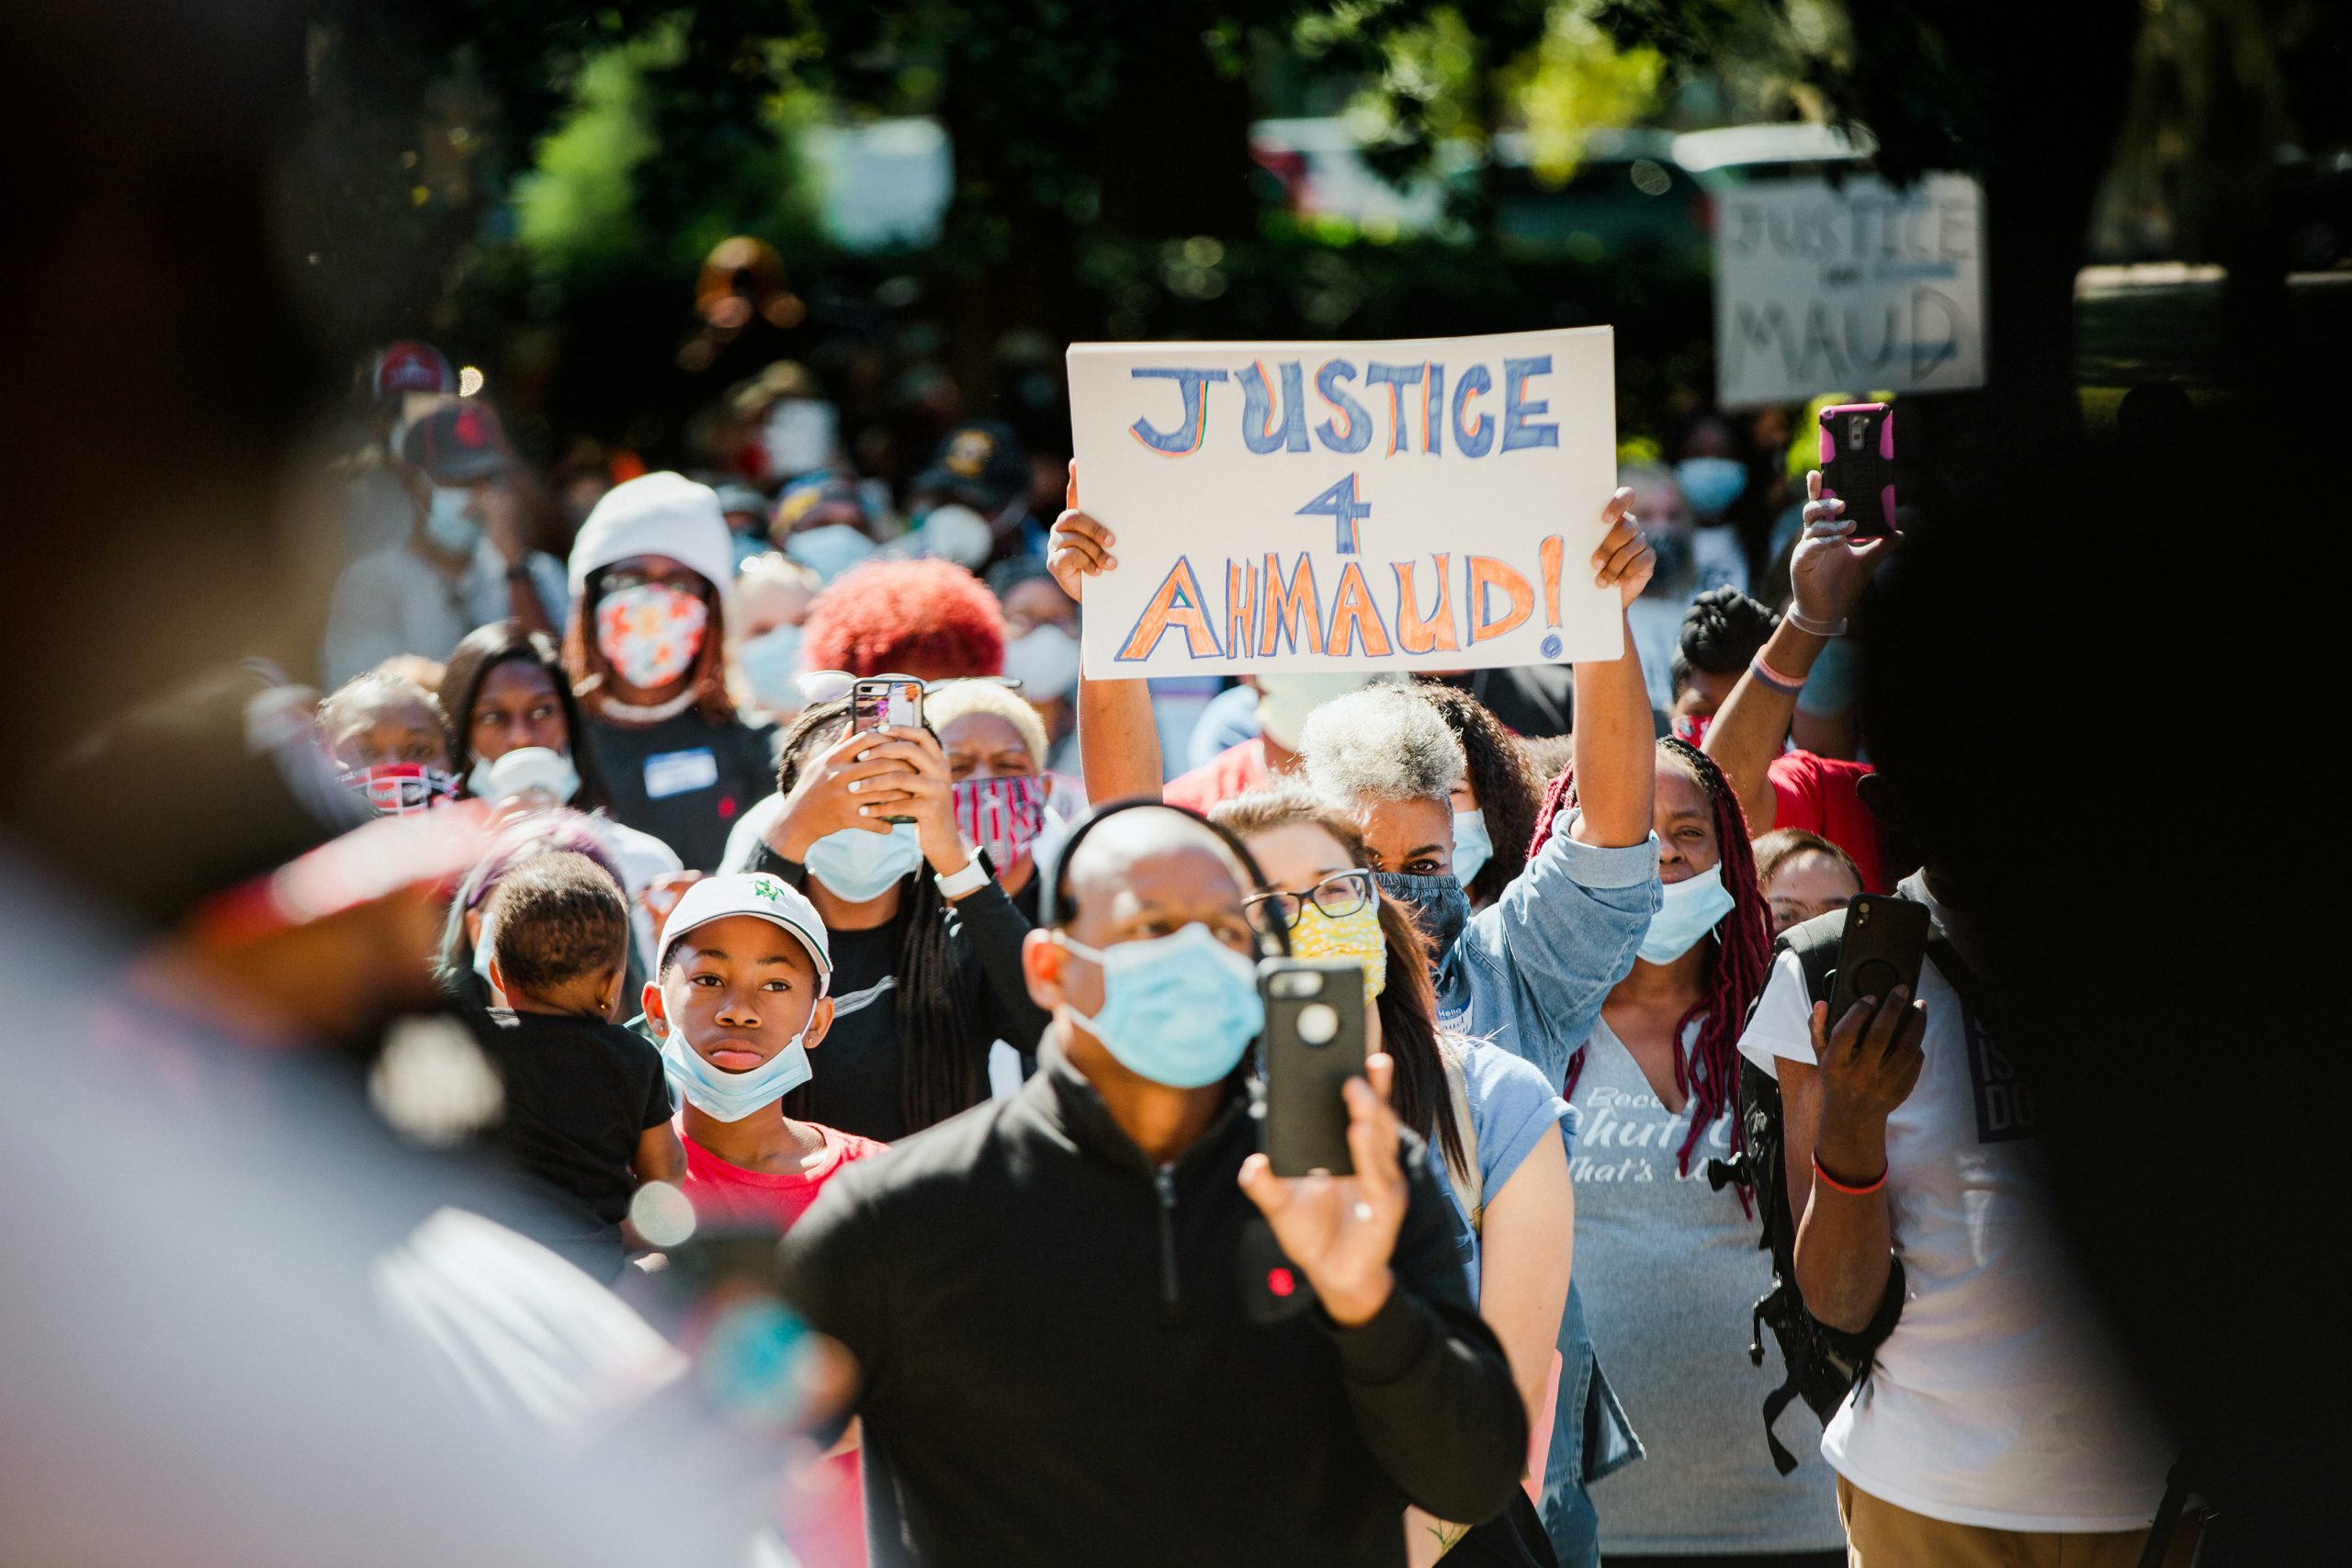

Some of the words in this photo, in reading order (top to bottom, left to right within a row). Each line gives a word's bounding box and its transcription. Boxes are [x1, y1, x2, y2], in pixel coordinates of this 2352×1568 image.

[1727, 192, 1975, 261] JUSTICE
[1727, 284, 1962, 385] MAUD
[1129, 355, 1560, 458] JUSTICE
[1294, 470, 1372, 554] 4
[1113, 534, 1565, 662] AHMAUD!
[1984, 1082, 2037, 1132] DO
